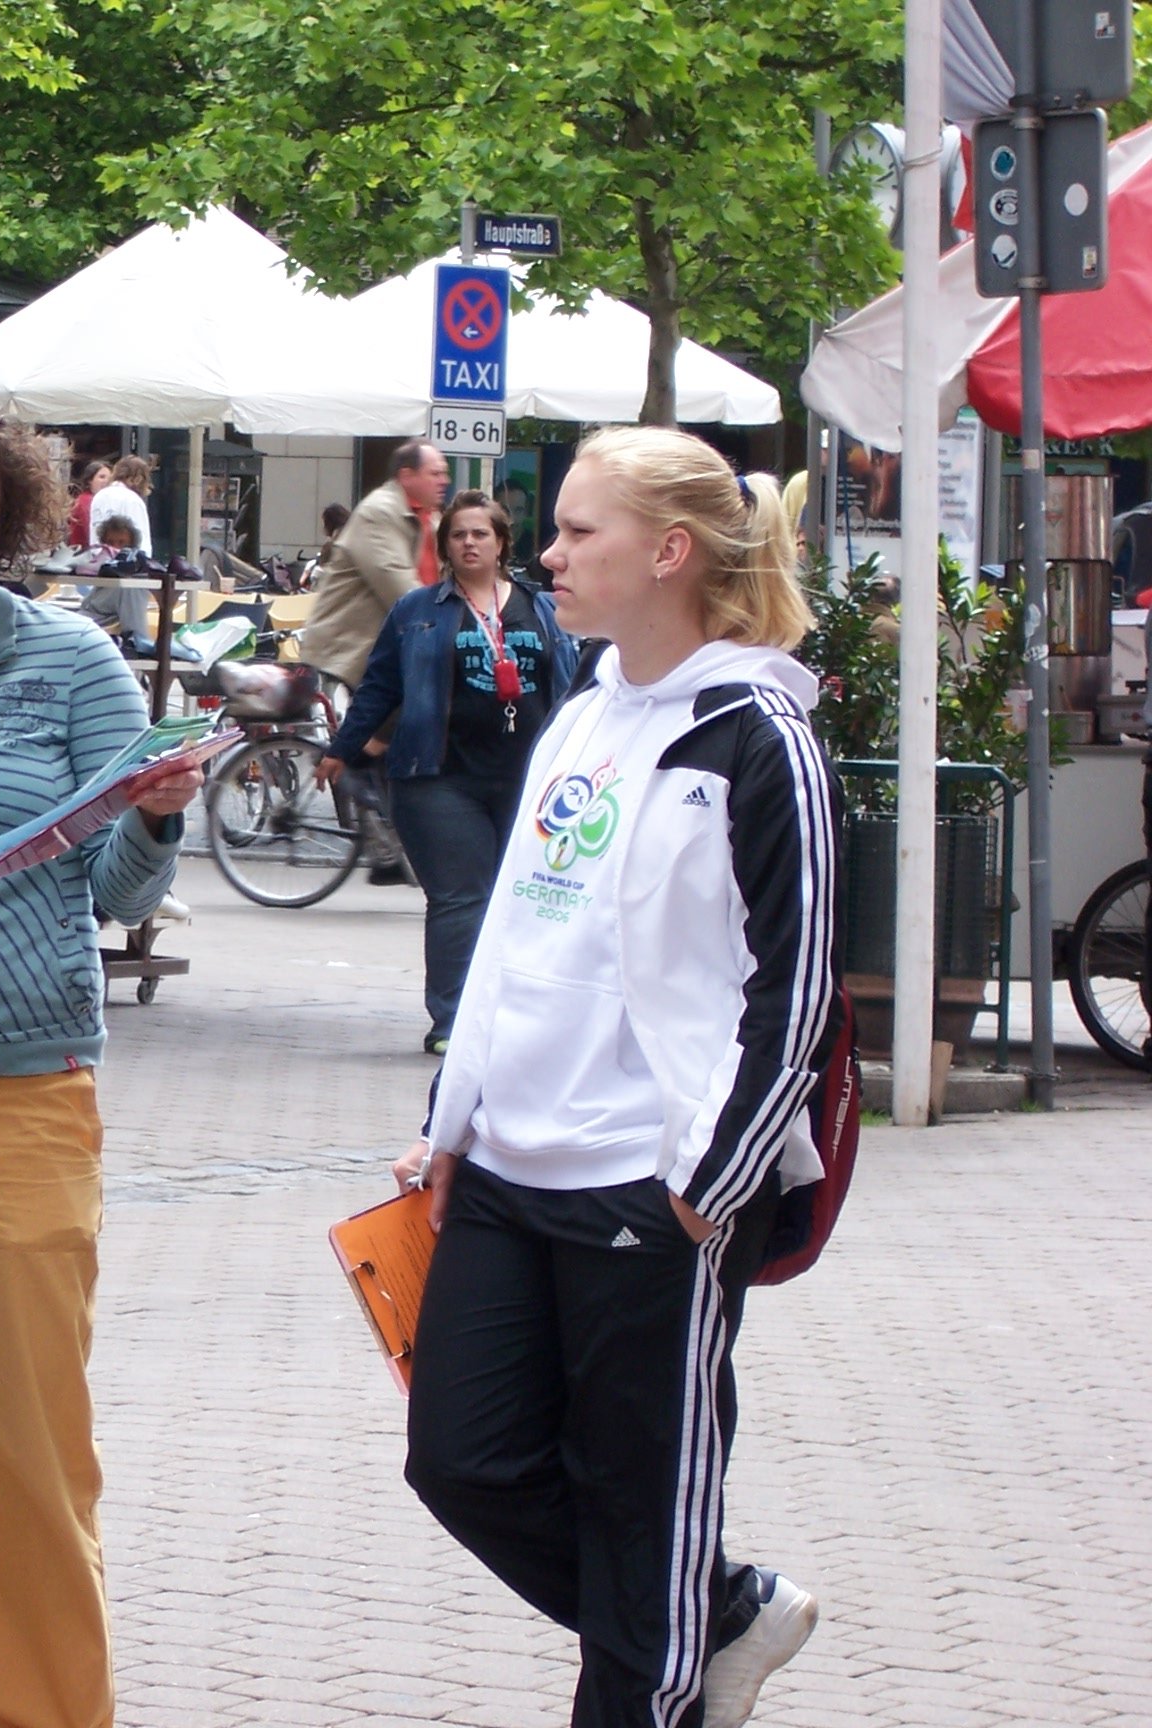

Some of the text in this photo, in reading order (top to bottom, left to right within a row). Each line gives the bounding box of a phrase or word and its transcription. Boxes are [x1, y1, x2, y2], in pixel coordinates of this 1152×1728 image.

[484, 219, 552, 247] Hauptstraße
[440, 359, 499, 391] TAXI
[681, 798, 711, 808] adidas
[532, 871, 586, 890] FIFA WORLD CUP
[512, 880, 594, 911] GERMANY
[611, 1237, 641, 1248] adidas
